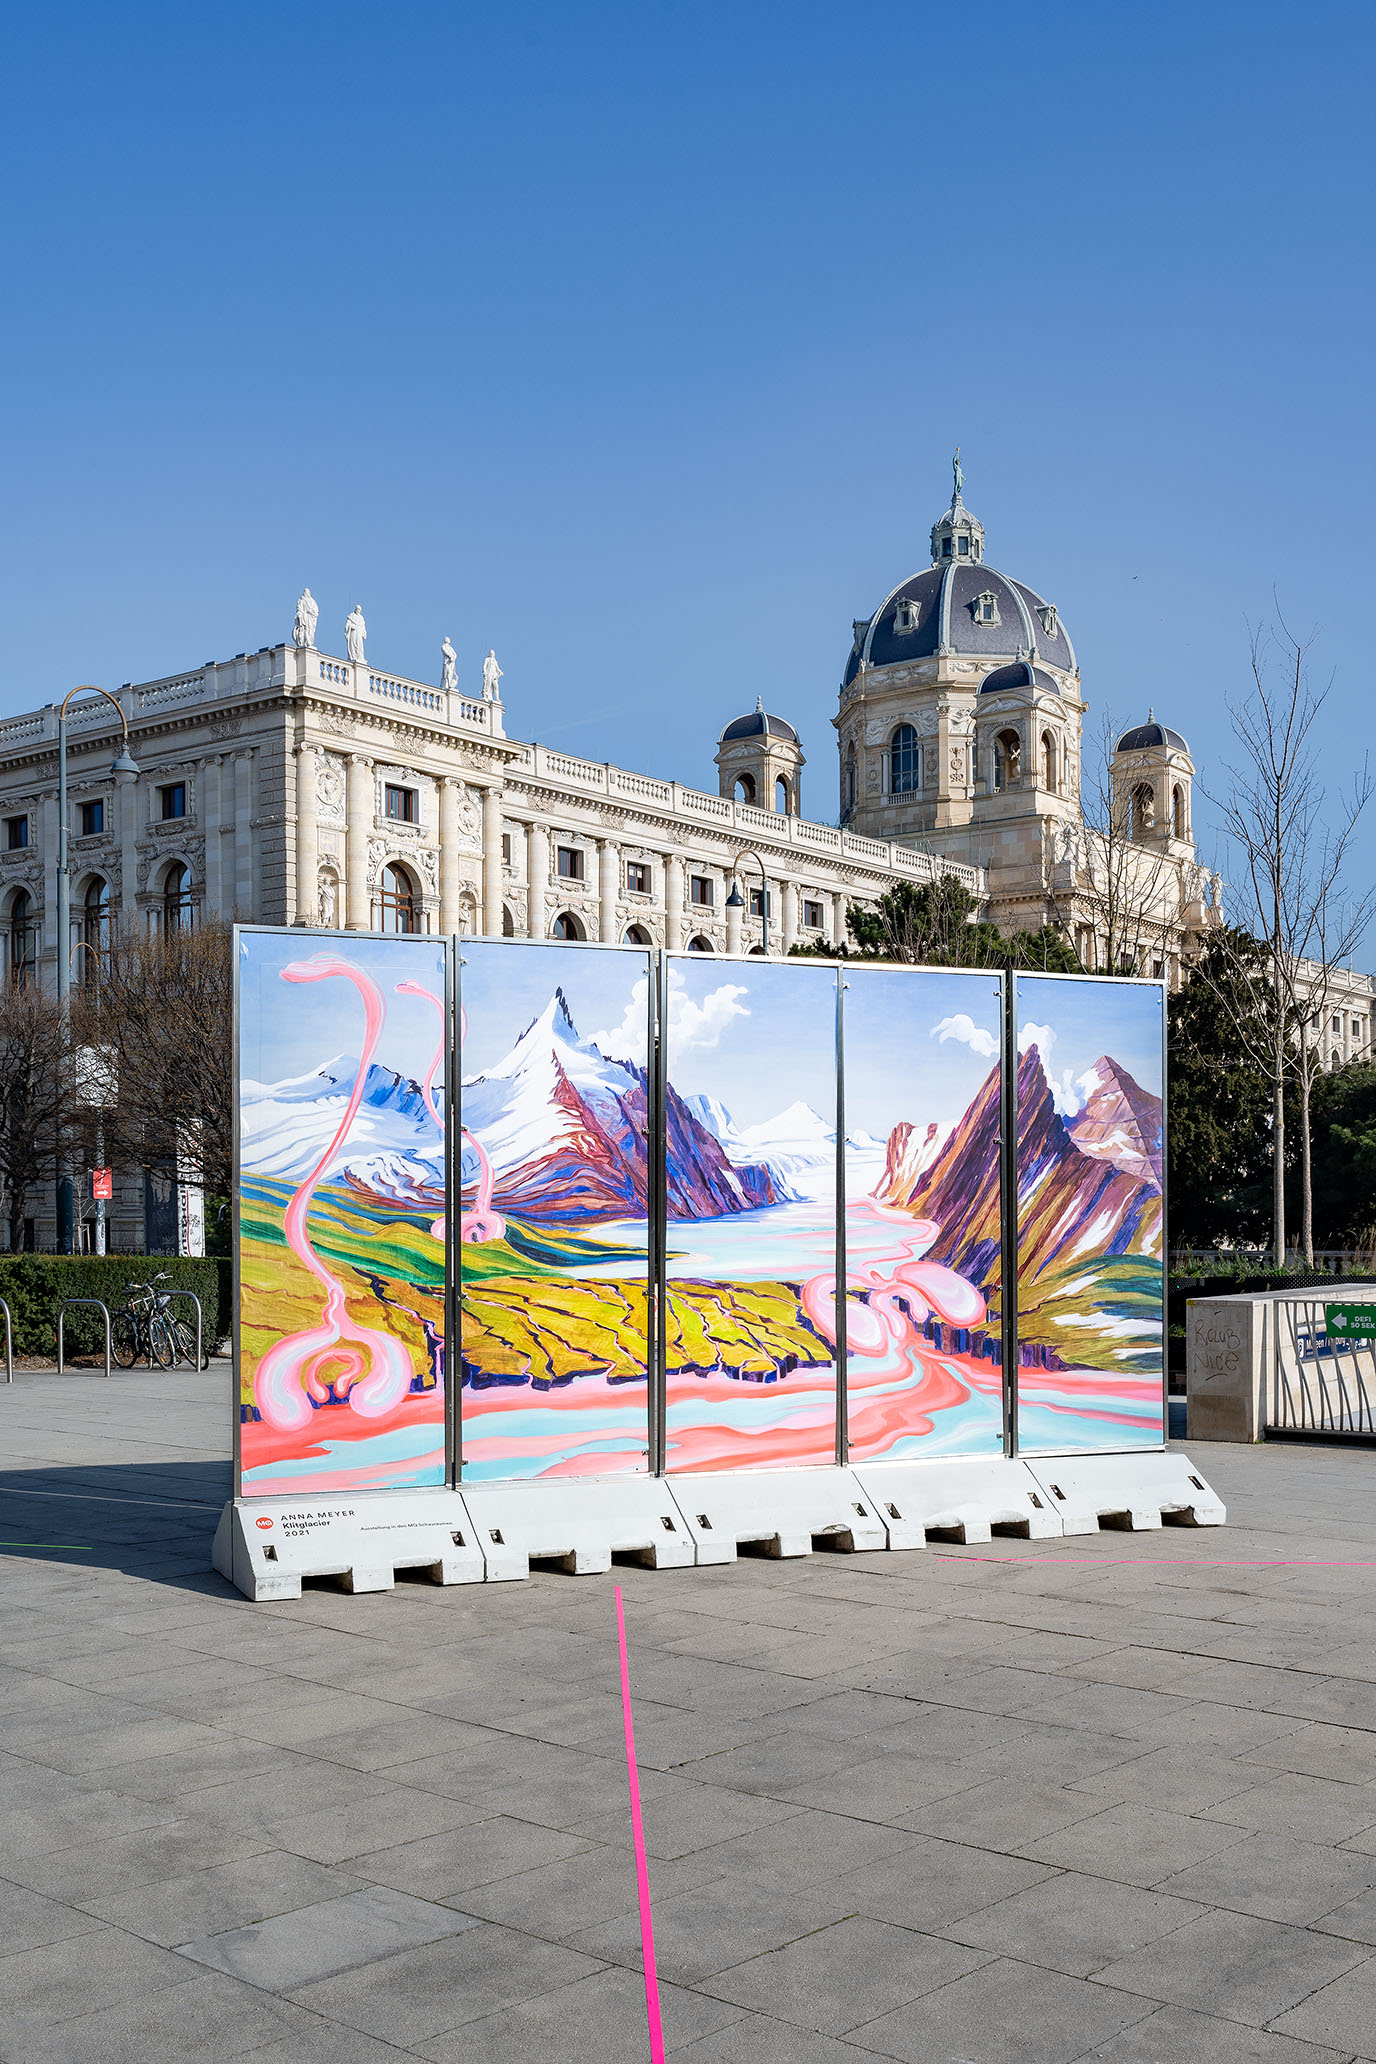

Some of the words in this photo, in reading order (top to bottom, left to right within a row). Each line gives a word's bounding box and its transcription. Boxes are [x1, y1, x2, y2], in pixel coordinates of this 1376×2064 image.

[317, 1510, 354, 1518] MEYER
[283, 1520, 331, 1529] Klitglacier
[284, 1529, 310, 1537] 2021
